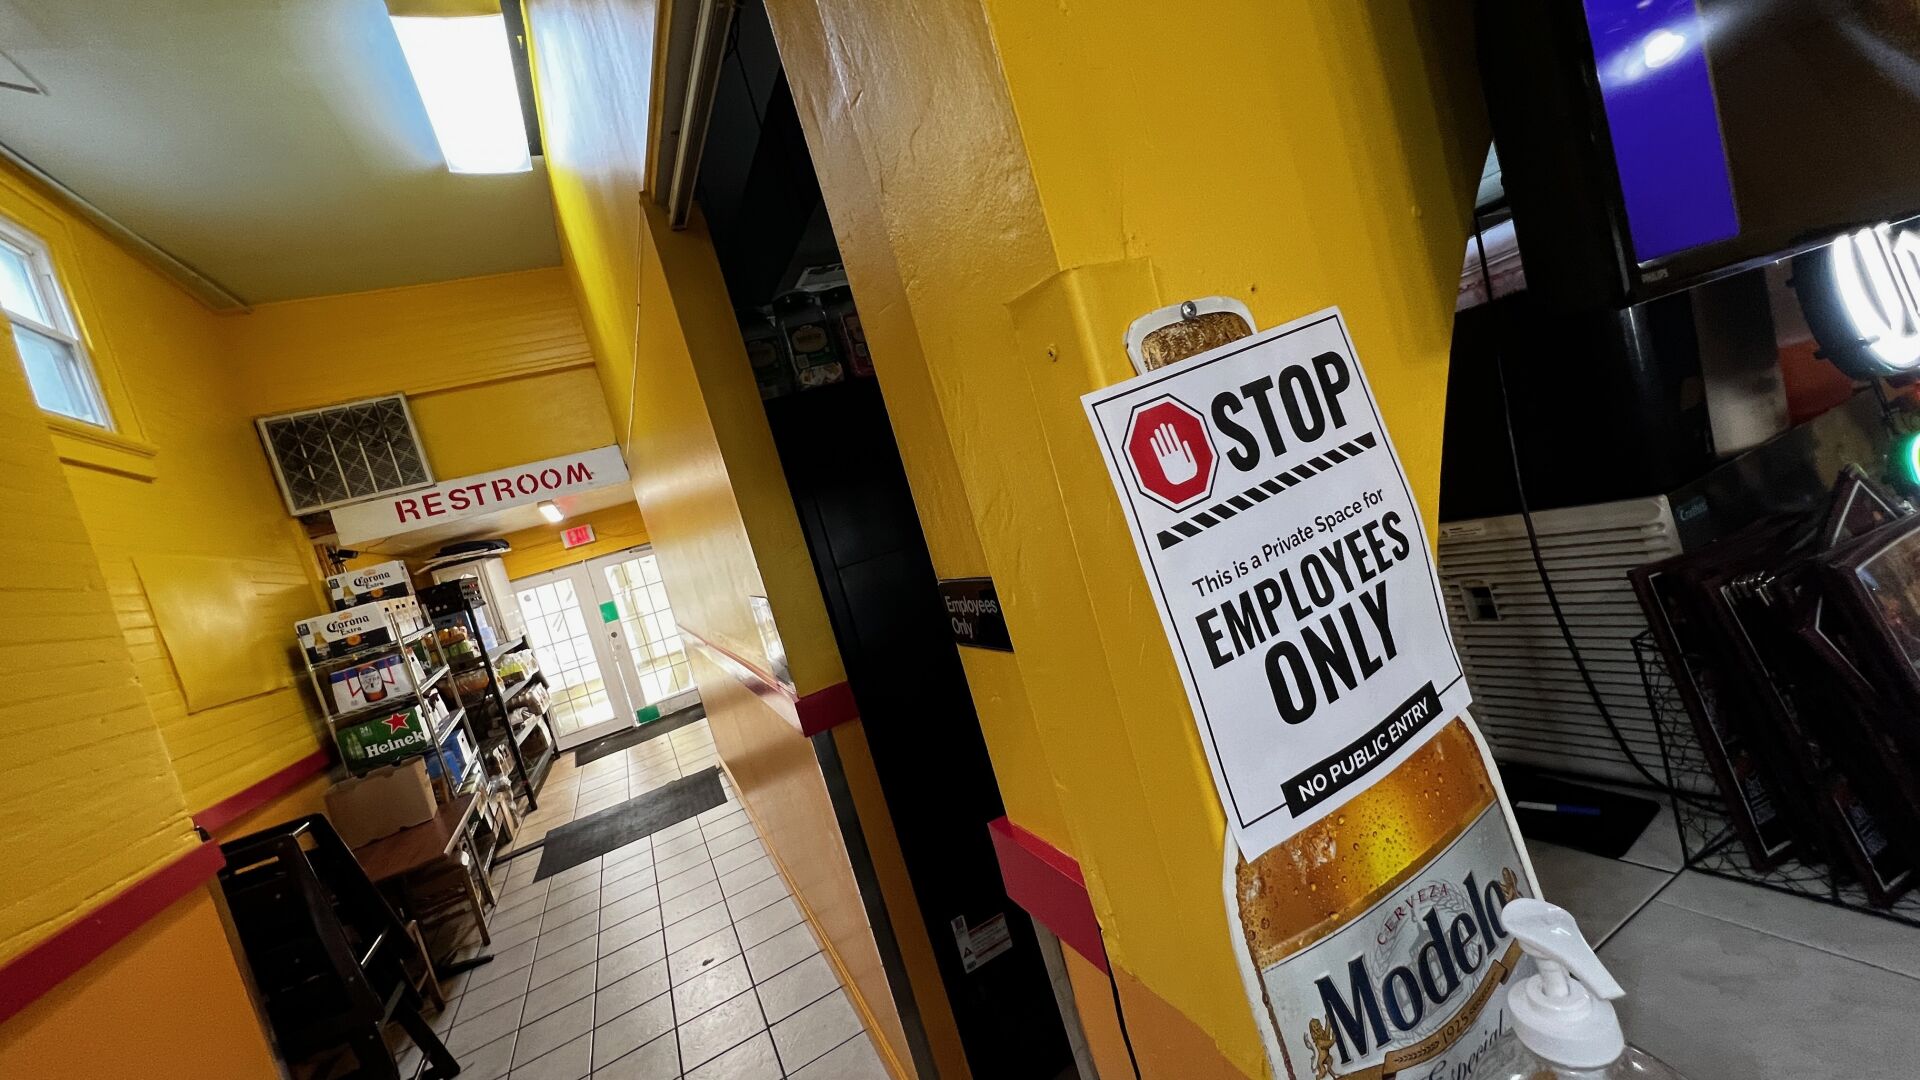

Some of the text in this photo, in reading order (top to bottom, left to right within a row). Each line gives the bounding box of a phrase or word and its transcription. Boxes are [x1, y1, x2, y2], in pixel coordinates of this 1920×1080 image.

[1211, 351, 1350, 472] STOP
[394, 462, 593, 523] RESTROOM
[566, 526, 590, 545] EXIT
[1192, 489, 1384, 597] This is a Private Space for
[354, 572, 391, 587] Corona
[1195, 511, 1410, 669] EMPLOYEES
[326, 615, 370, 633] Corona
[944, 595, 998, 617] Employees
[951, 617, 974, 639] Only
[339, 627, 362, 636] Extra
[1264, 579, 1398, 725] ONLY
[365, 731, 426, 758] Heinek
[1298, 696, 1429, 802] NO PUBLIC ENTRY
[1376, 883, 1450, 946] CERVEZA
[1314, 870, 1509, 1065] Modelo
[1442, 1014, 1470, 1045] 1925
